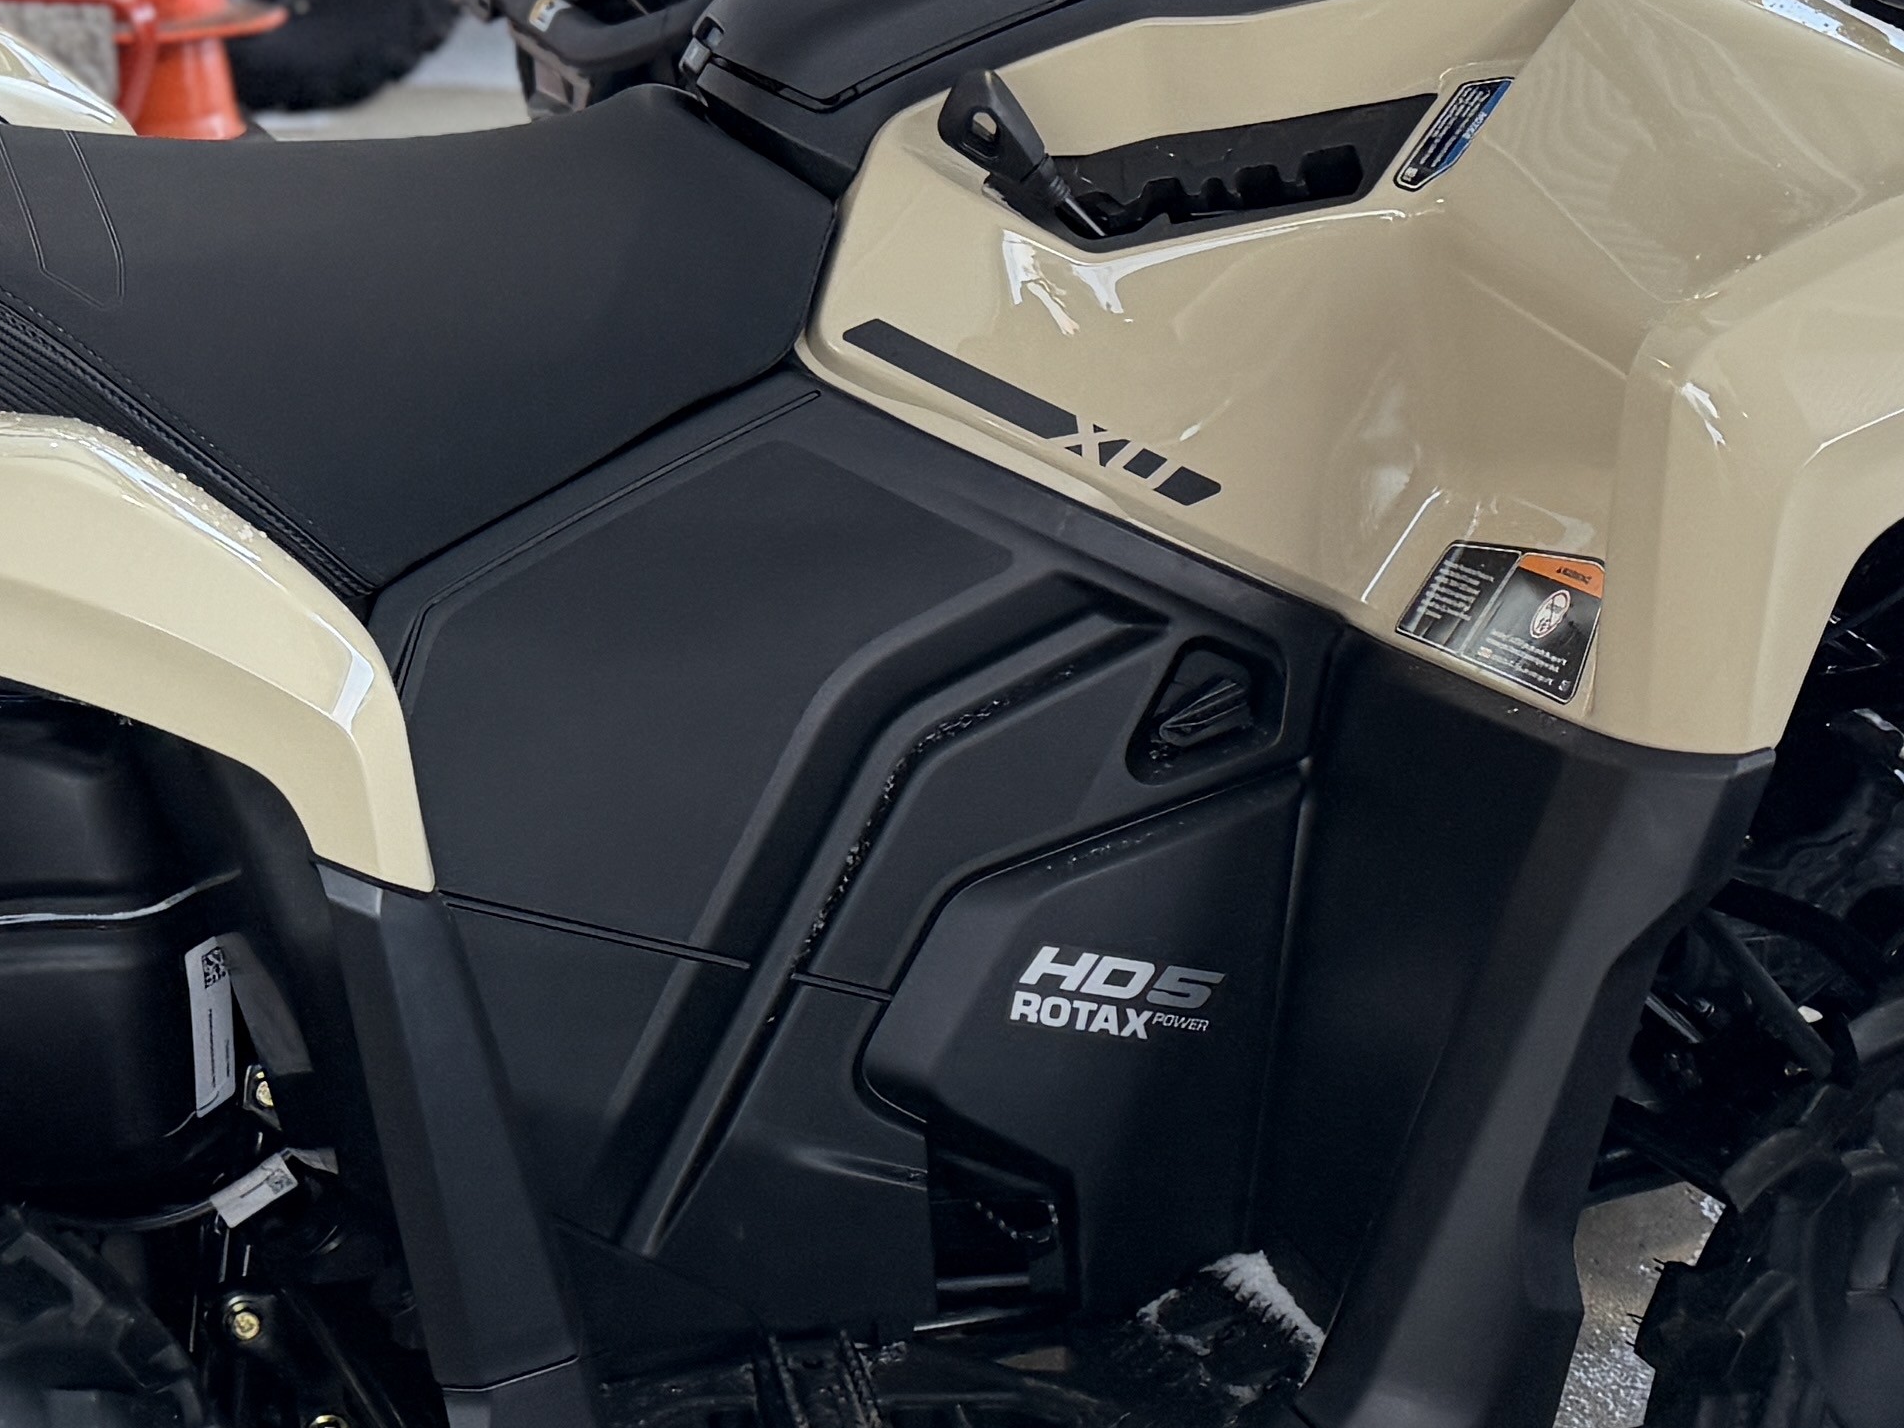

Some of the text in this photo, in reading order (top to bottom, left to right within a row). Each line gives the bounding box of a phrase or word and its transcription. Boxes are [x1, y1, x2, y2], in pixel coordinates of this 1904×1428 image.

[1018, 945, 1227, 1009] HD5
[1009, 990, 1210, 1040] ROTAX POWER
